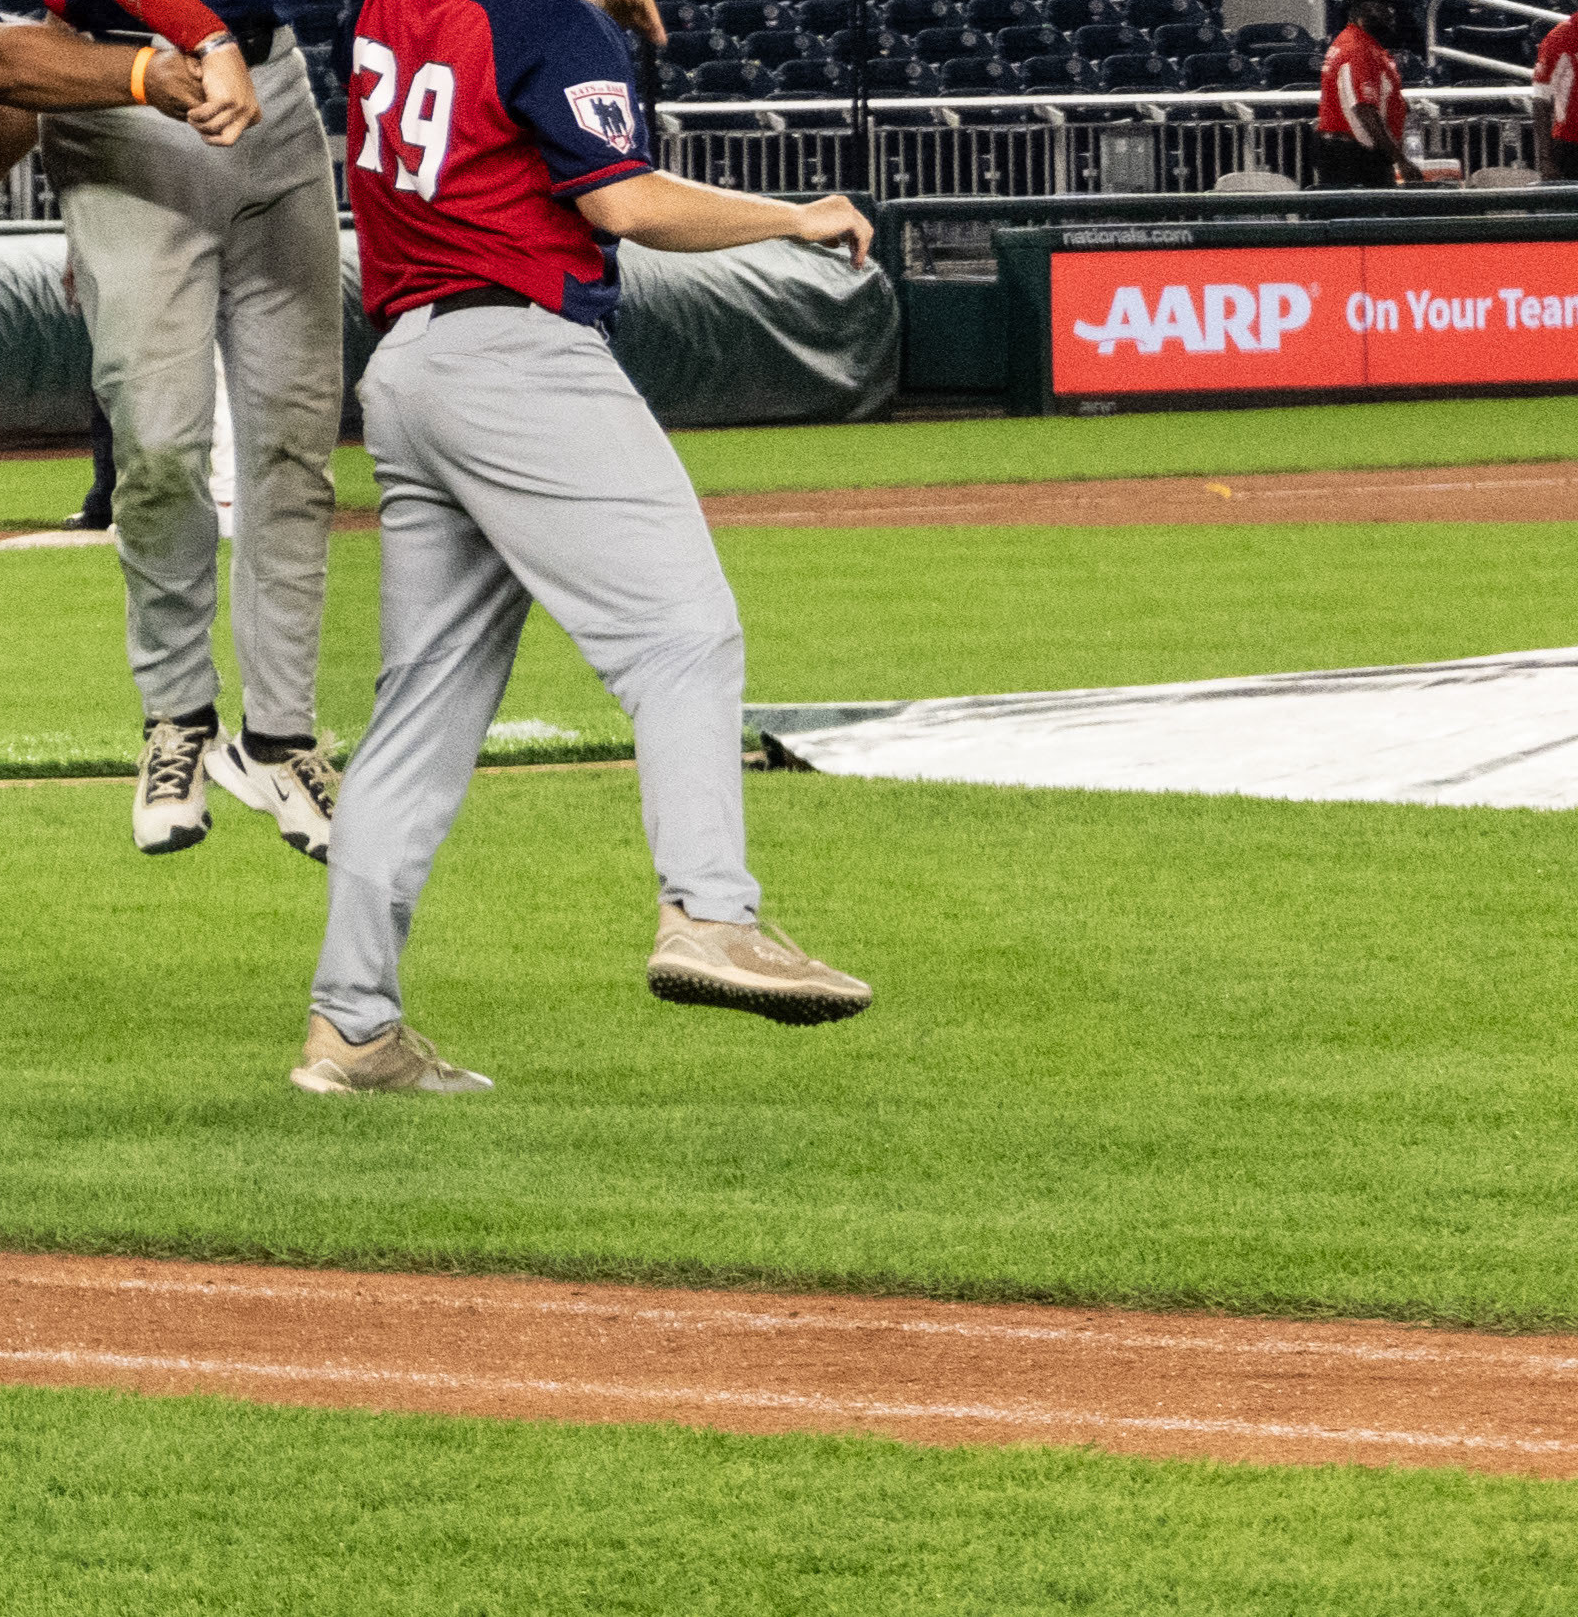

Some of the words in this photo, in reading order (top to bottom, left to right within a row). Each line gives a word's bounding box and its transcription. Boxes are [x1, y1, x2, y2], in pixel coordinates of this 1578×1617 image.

[1073, 283, 1312, 354] AARP
[1345, 291, 1399, 332] On
[1405, 289, 1493, 332] Your
